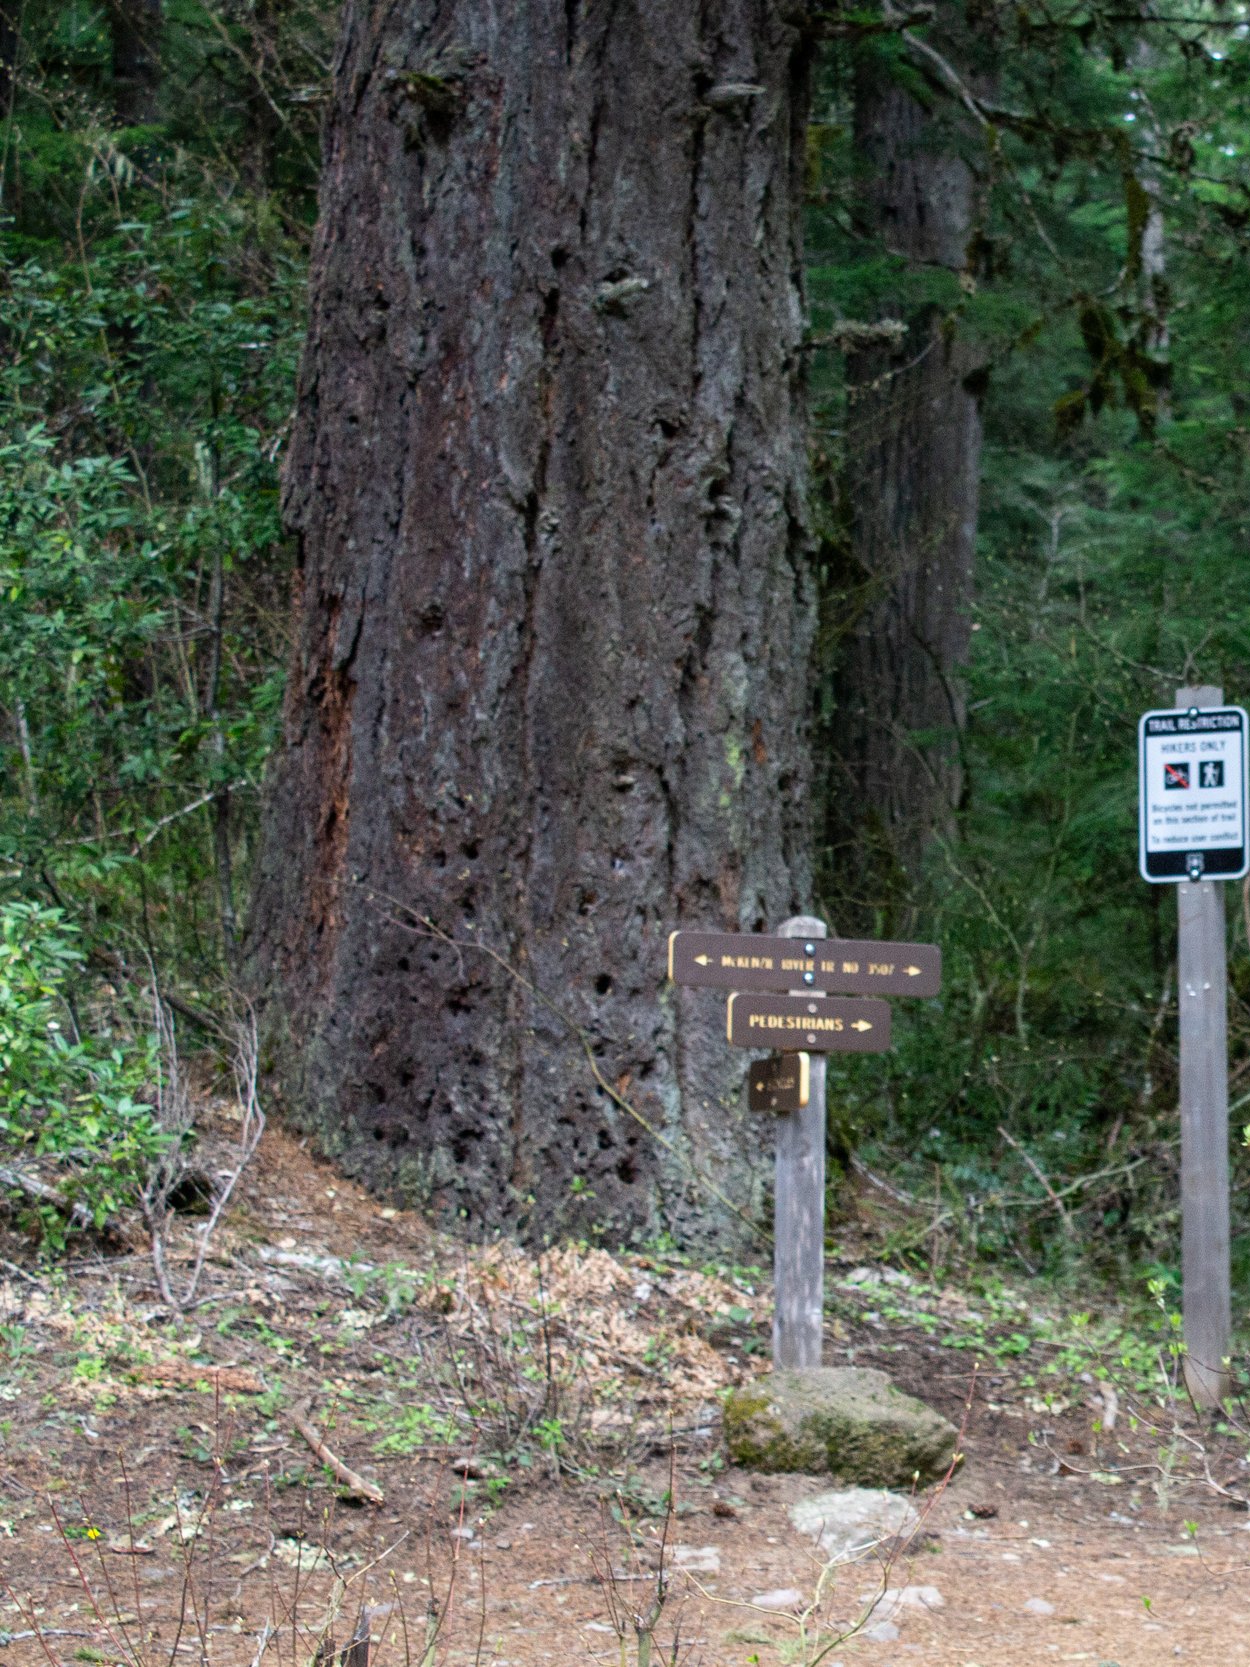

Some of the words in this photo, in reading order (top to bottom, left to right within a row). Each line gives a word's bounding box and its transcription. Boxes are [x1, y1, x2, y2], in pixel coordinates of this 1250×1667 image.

[1149, 719, 1177, 731] TRAIL
[1161, 743, 1196, 753] HIKERS
[1200, 741, 1226, 751] ONLY
[781, 958, 815, 972] RIVER
[749, 1013, 844, 1032] PEDESTRIANS
